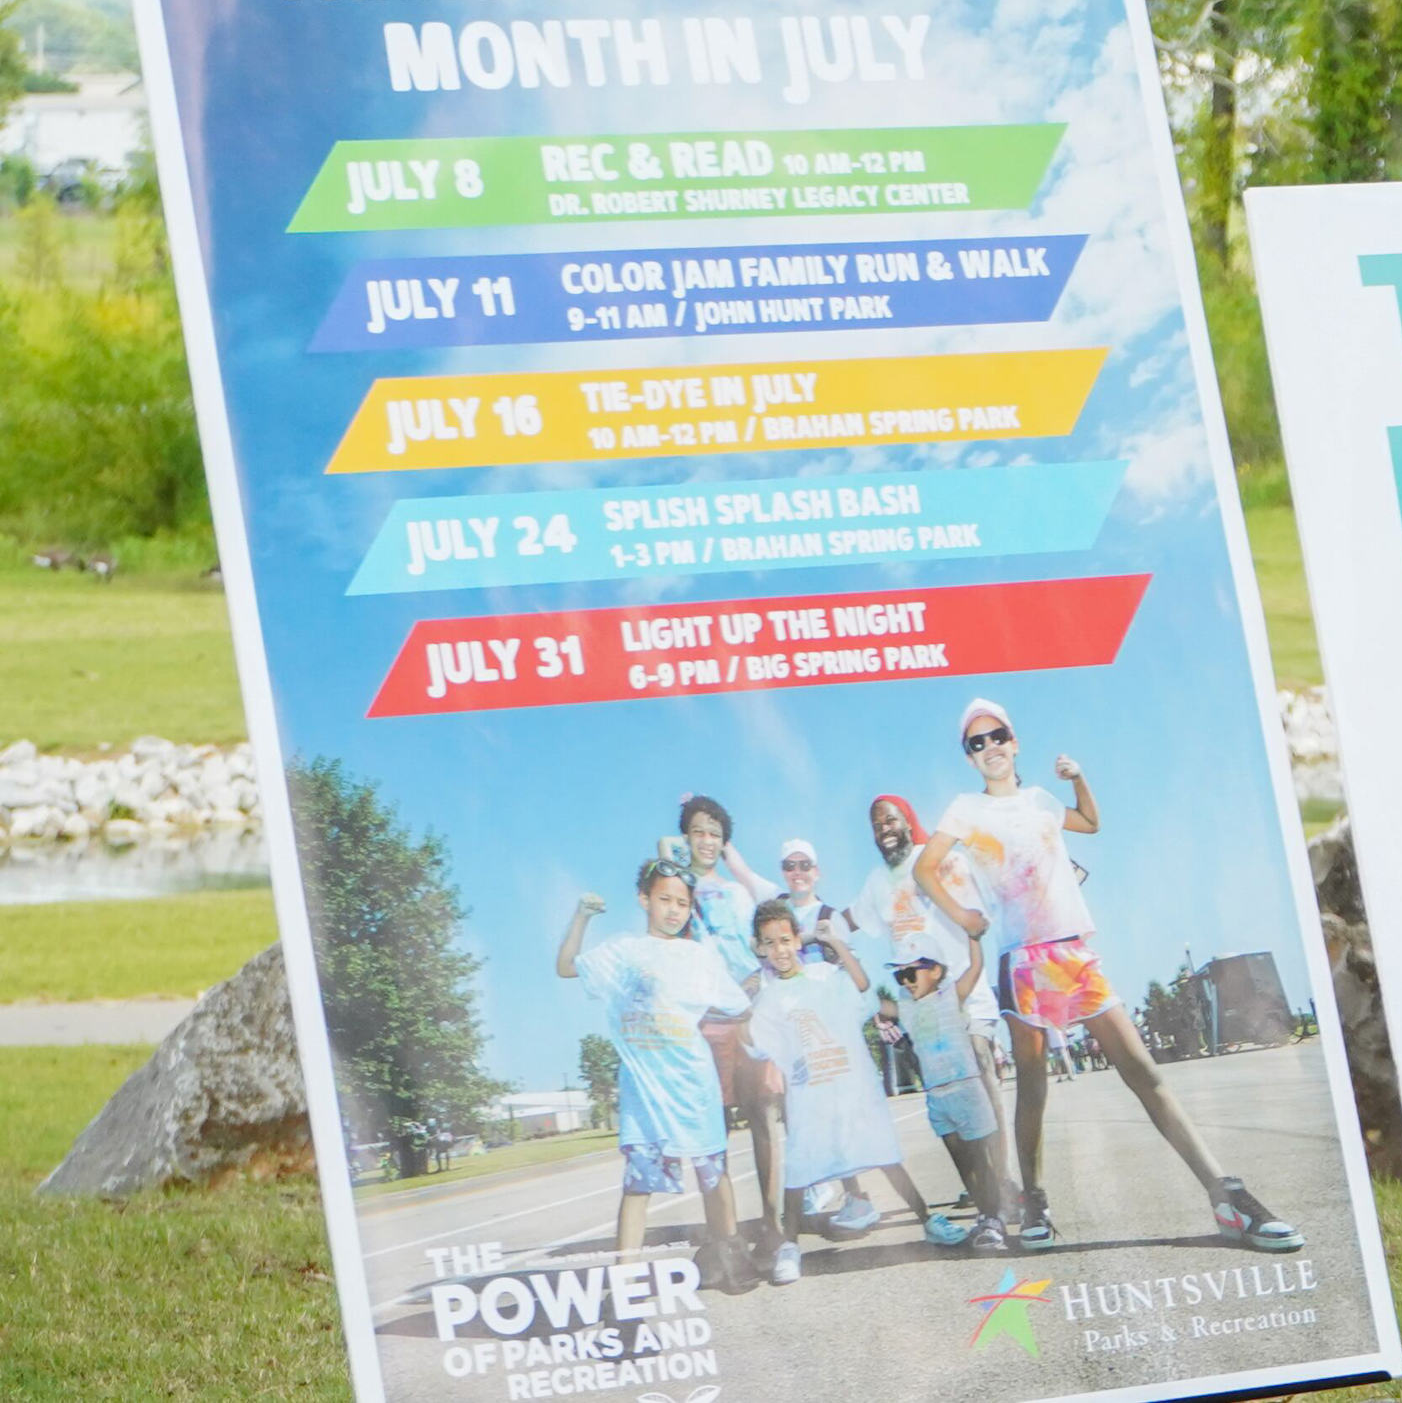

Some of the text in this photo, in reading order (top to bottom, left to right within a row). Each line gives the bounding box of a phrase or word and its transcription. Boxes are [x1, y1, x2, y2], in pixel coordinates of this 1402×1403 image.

[384, 15, 930, 105] MONTH IN JULY
[541, 144, 619, 182] REC
[628, 143, 664, 179] &
[670, 141, 773, 178] READ
[783, 154, 808, 176] 10
[890, 151, 926, 172] PM
[347, 159, 484, 214] JULY 8
[549, 183, 970, 215] DR. ROBERT SHURNEY LEGACY CENTER
[562, 248, 1050, 298] COLOR JAM FAMILY RUN & WALK
[366, 276, 515, 334] JULY 11
[567, 296, 893, 333] 9-11 AM / JOHN HUNT PARK
[580, 373, 817, 413] TIE-DYE IN JULY
[386, 395, 543, 455] JULY 16
[588, 427, 616, 449] 10
[699, 421, 738, 444] PM
[745, 416, 756, 442] /
[763, 413, 865, 441] BRAHAN
[868, 408, 954, 435] SPRING
[957, 406, 1021, 431] PARK
[603, 485, 921, 532] SPLISH SPLASH BASH
[406, 514, 578, 576] JULY 24
[611, 524, 981, 568] 1-3 PM / BRAHAN SPRING PARK
[621, 602, 926, 651] LIGHT UP THE NIGHT
[426, 635, 585, 698] JULY 31
[628, 644, 949, 689] 6-9 PM / BIG SPRING PARK
[425, 1242, 506, 1277] THE
[432, 1257, 708, 1342] POWER
[1059, 1259, 1318, 1321] HUNTSVILLE
[444, 1317, 712, 1377] OF PARKS AND
[1084, 1306, 1317, 1352] Parks & Recreation
[507, 1349, 718, 1400] RECREATION
